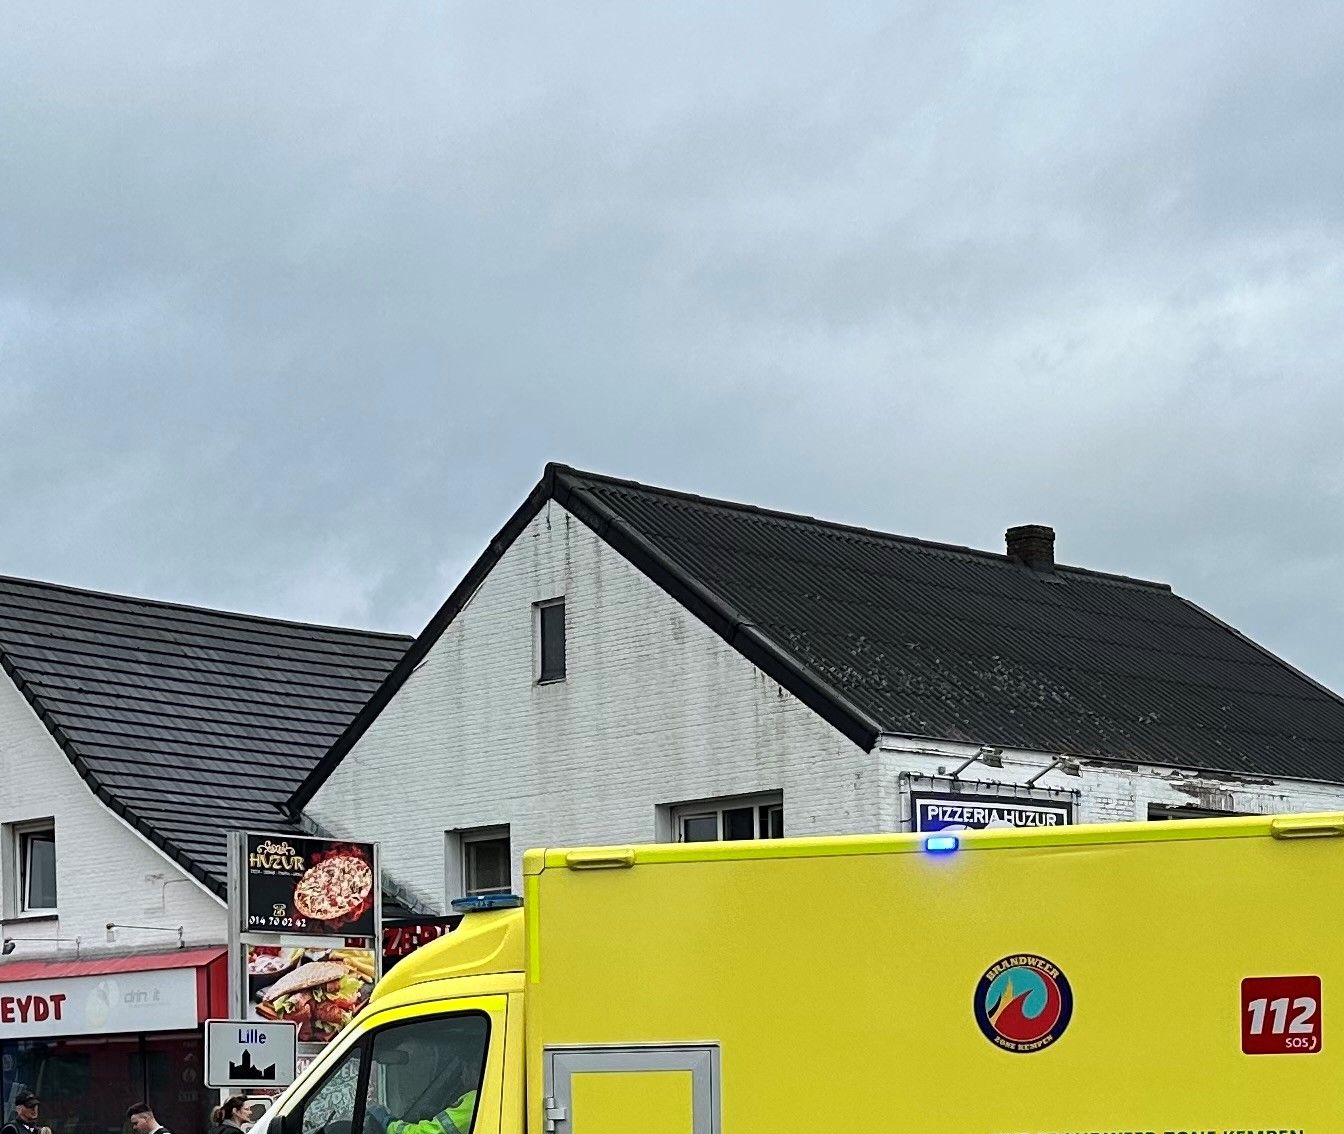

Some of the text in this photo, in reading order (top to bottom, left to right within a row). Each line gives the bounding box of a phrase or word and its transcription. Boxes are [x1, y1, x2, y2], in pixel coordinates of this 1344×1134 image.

[927, 805, 1057, 827] PIZZERIA HUZUR
[986, 956, 1060, 981] BRANDWEER
[1247, 996, 1317, 1035] 112
[238, 1029, 267, 1044] Lille
[1285, 1037, 1309, 1049] SOS
